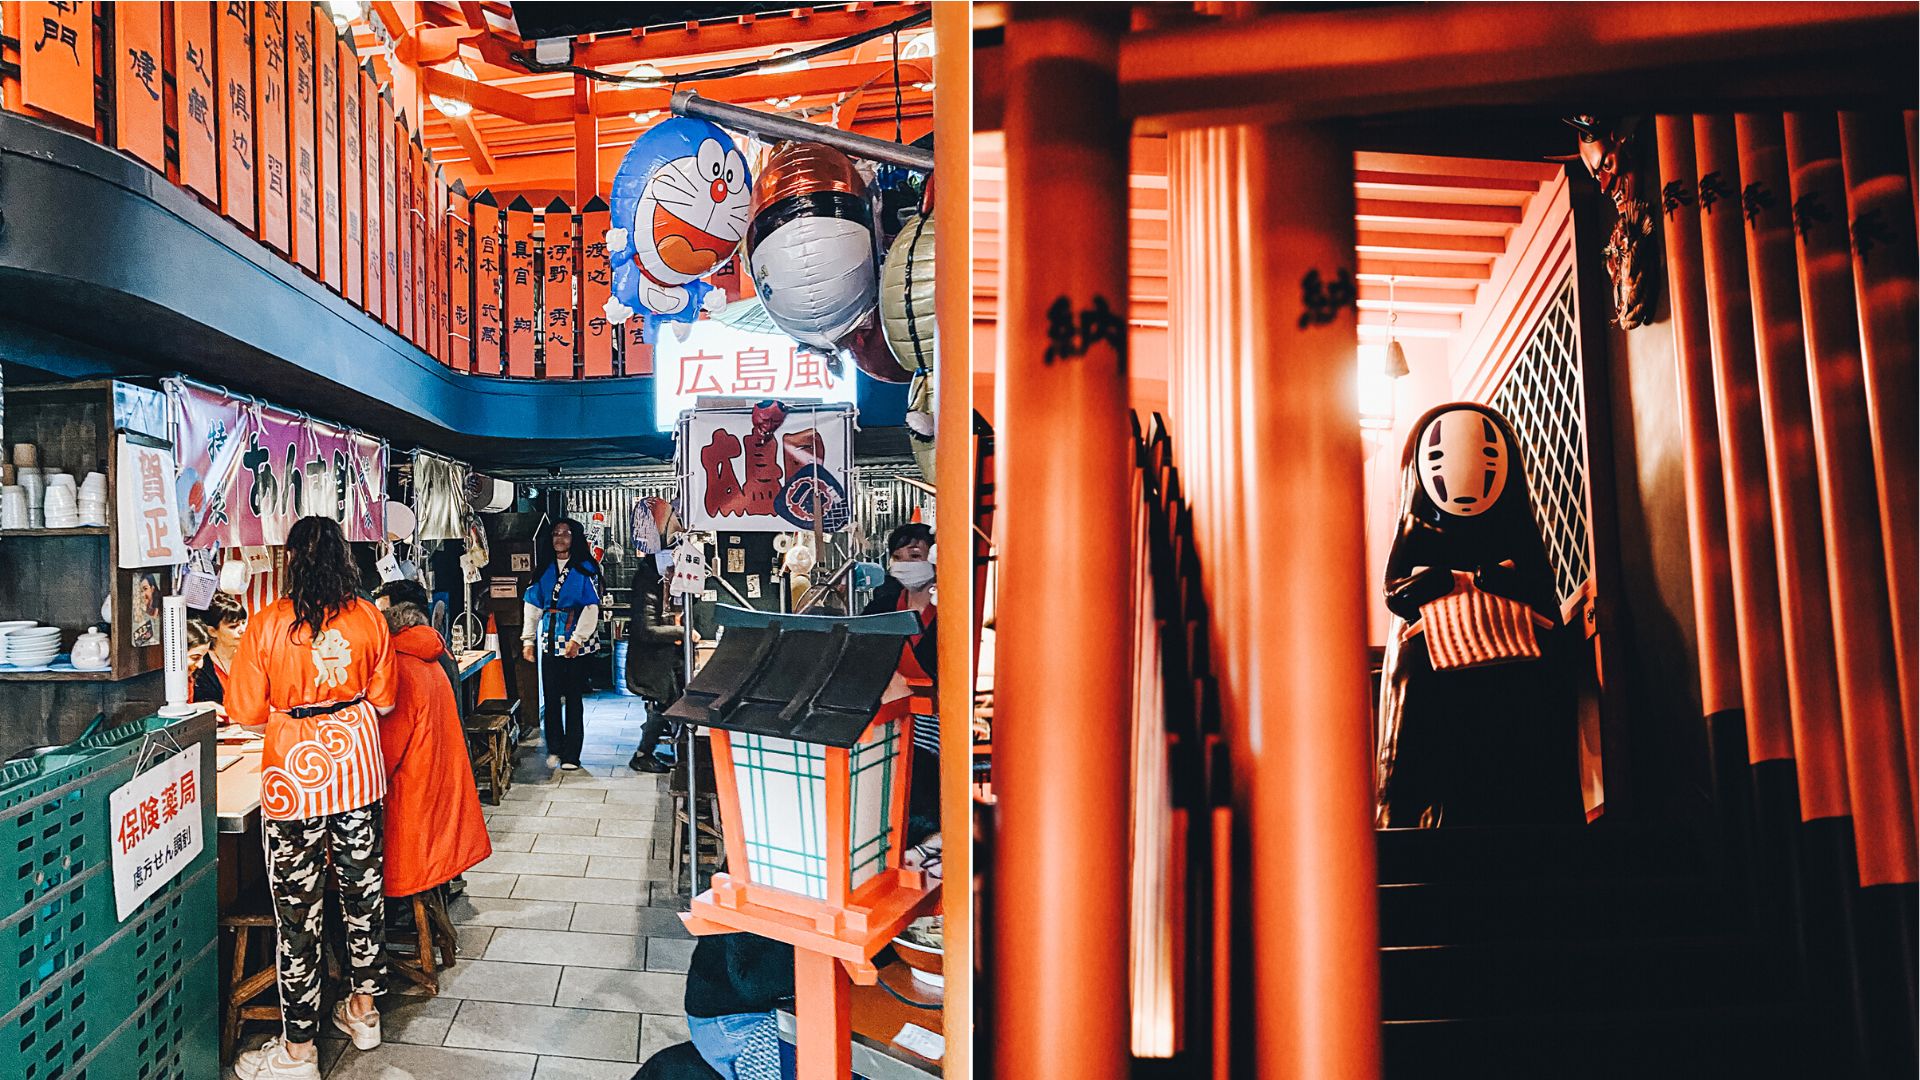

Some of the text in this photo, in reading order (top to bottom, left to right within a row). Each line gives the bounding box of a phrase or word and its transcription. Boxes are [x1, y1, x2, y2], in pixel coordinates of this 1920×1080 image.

[675, 347, 835, 397] 広島風
[117, 770, 196, 854] 保険薬局
